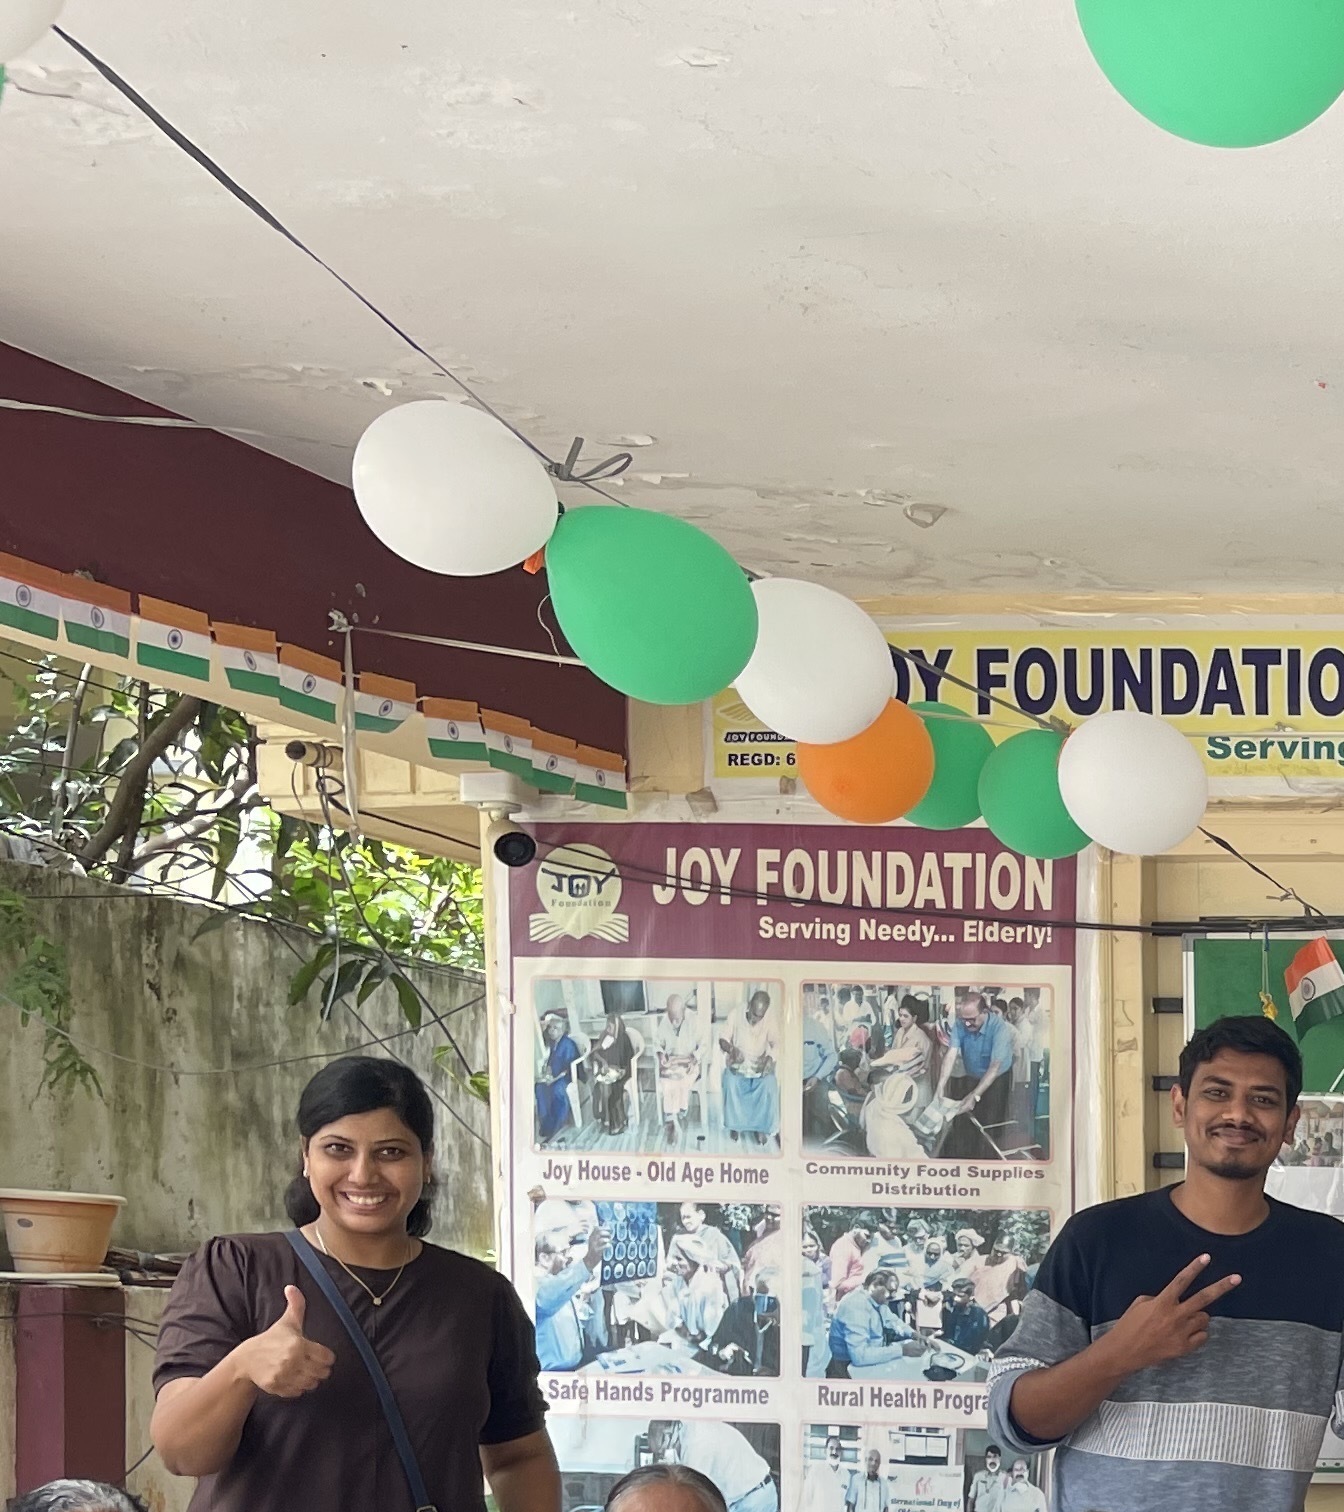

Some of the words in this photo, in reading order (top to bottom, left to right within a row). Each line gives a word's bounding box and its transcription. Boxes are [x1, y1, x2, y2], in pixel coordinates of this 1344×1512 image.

[726, 733, 746, 742] JOY
[749, 733, 789, 742] FOUND
[728, 753, 780, 766] REGD:
[786, 753, 796, 766] 6
[541, 868, 616, 899] JOY
[652, 846, 742, 906] JOY
[756, 849, 1054, 912] FOUNDATION
[551, 898, 612, 909] Foundation
[758, 916, 851, 945] Serving
[858, 918, 955, 945] Needy...
[962, 920, 1053, 949] Elderly!
[542, 1160, 573, 1186] Joy
[577, 1160, 633, 1184] House
[647, 1161, 675, 1184] Old
[679, 1162, 718, 1188] Age
[720, 1162, 769, 1185] Home
[805, 1162, 911, 1181] Community
[916, 1164, 961, 1178] Food
[966, 1165, 1045, 1183] Supplies
[871, 1182, 981, 1198] Distribution
[548, 1378, 588, 1400] Safe
[595, 1380, 655, 1402] Hands
[661, 1381, 769, 1409] Programme
[818, 1384, 864, 1408] Rural
[869, 1386, 927, 1409] Health
[932, 1387, 989, 1415] Progra
